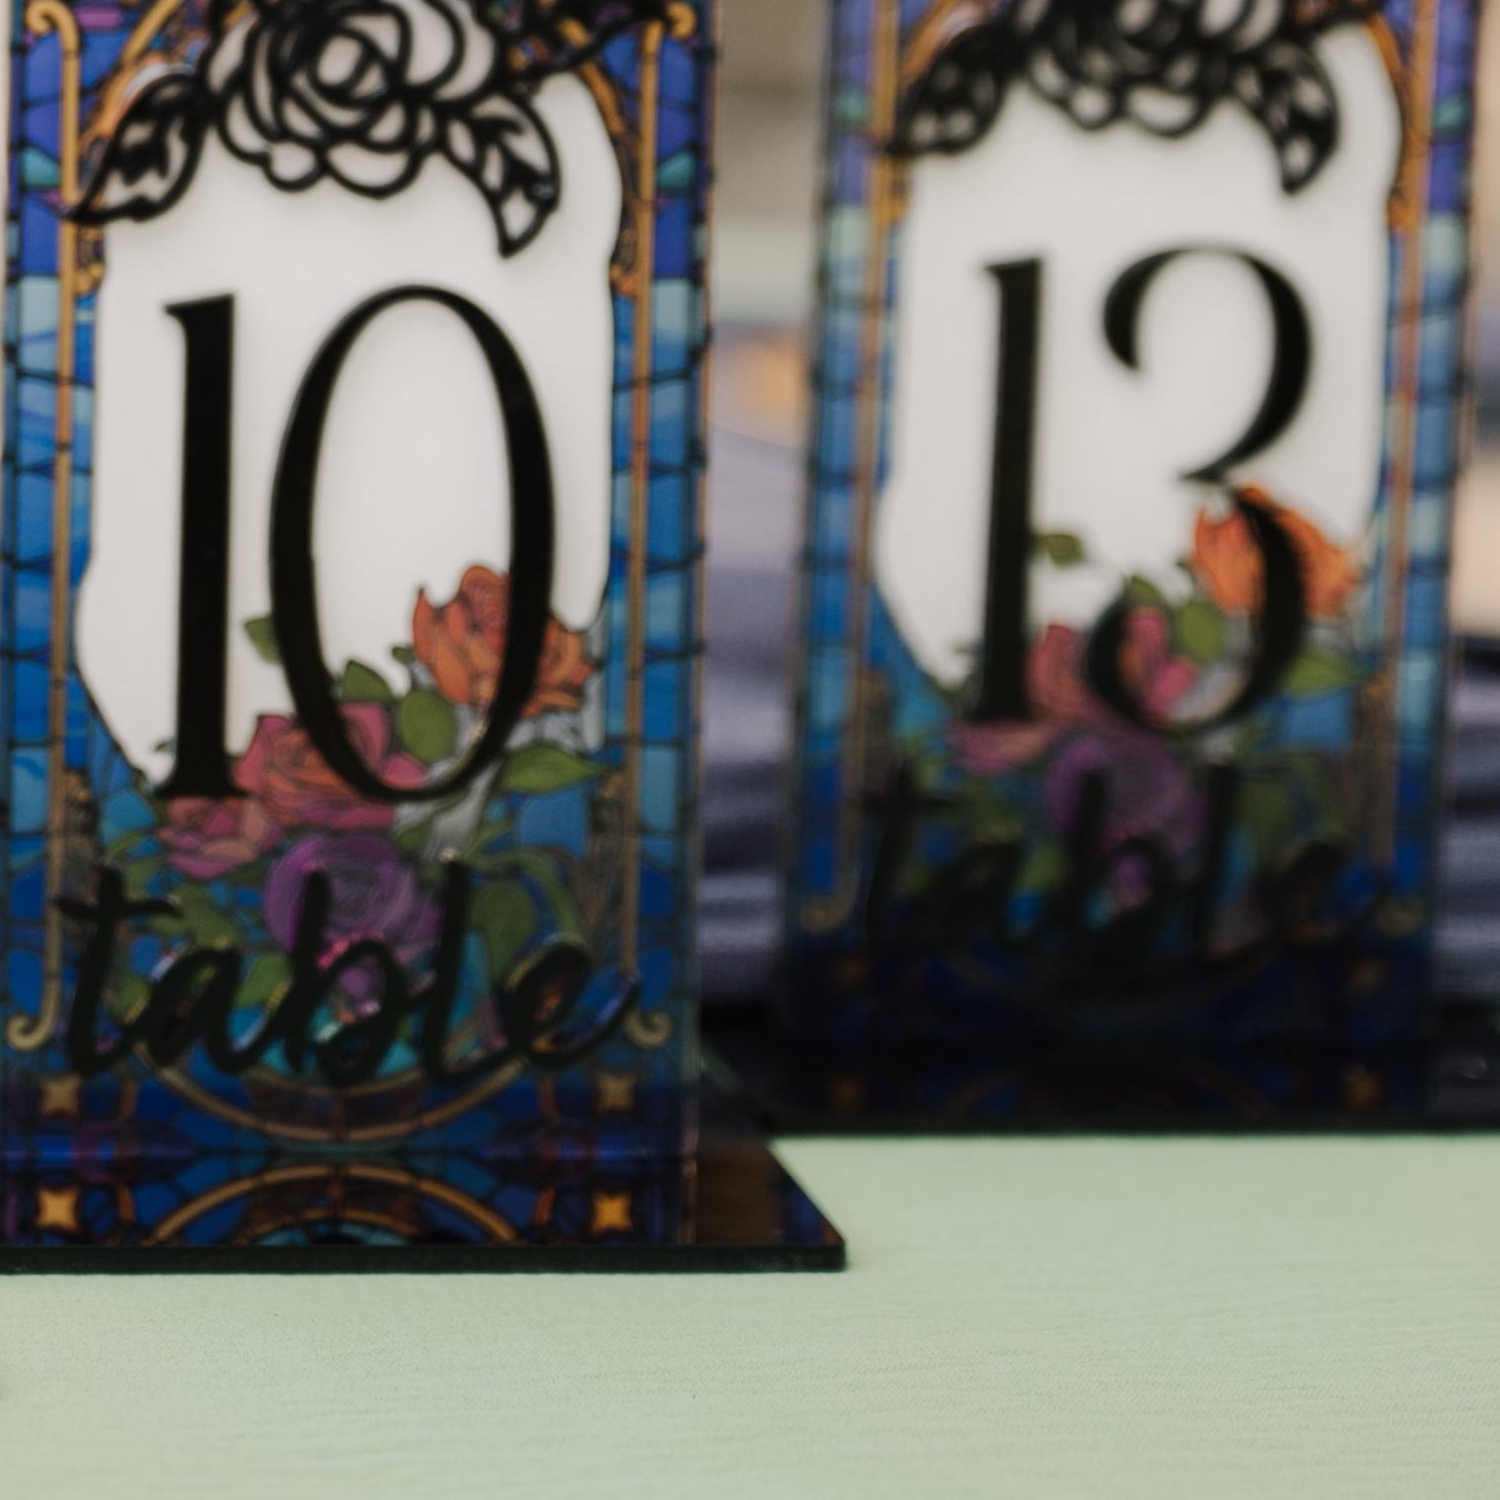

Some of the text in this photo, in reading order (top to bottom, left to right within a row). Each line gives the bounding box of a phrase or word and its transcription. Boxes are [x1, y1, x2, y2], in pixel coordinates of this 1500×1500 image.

[153, 284, 555, 801] 10
[964, 243, 1313, 739] 13
[54, 852, 639, 1087] table
[859, 758, 1380, 968] table
